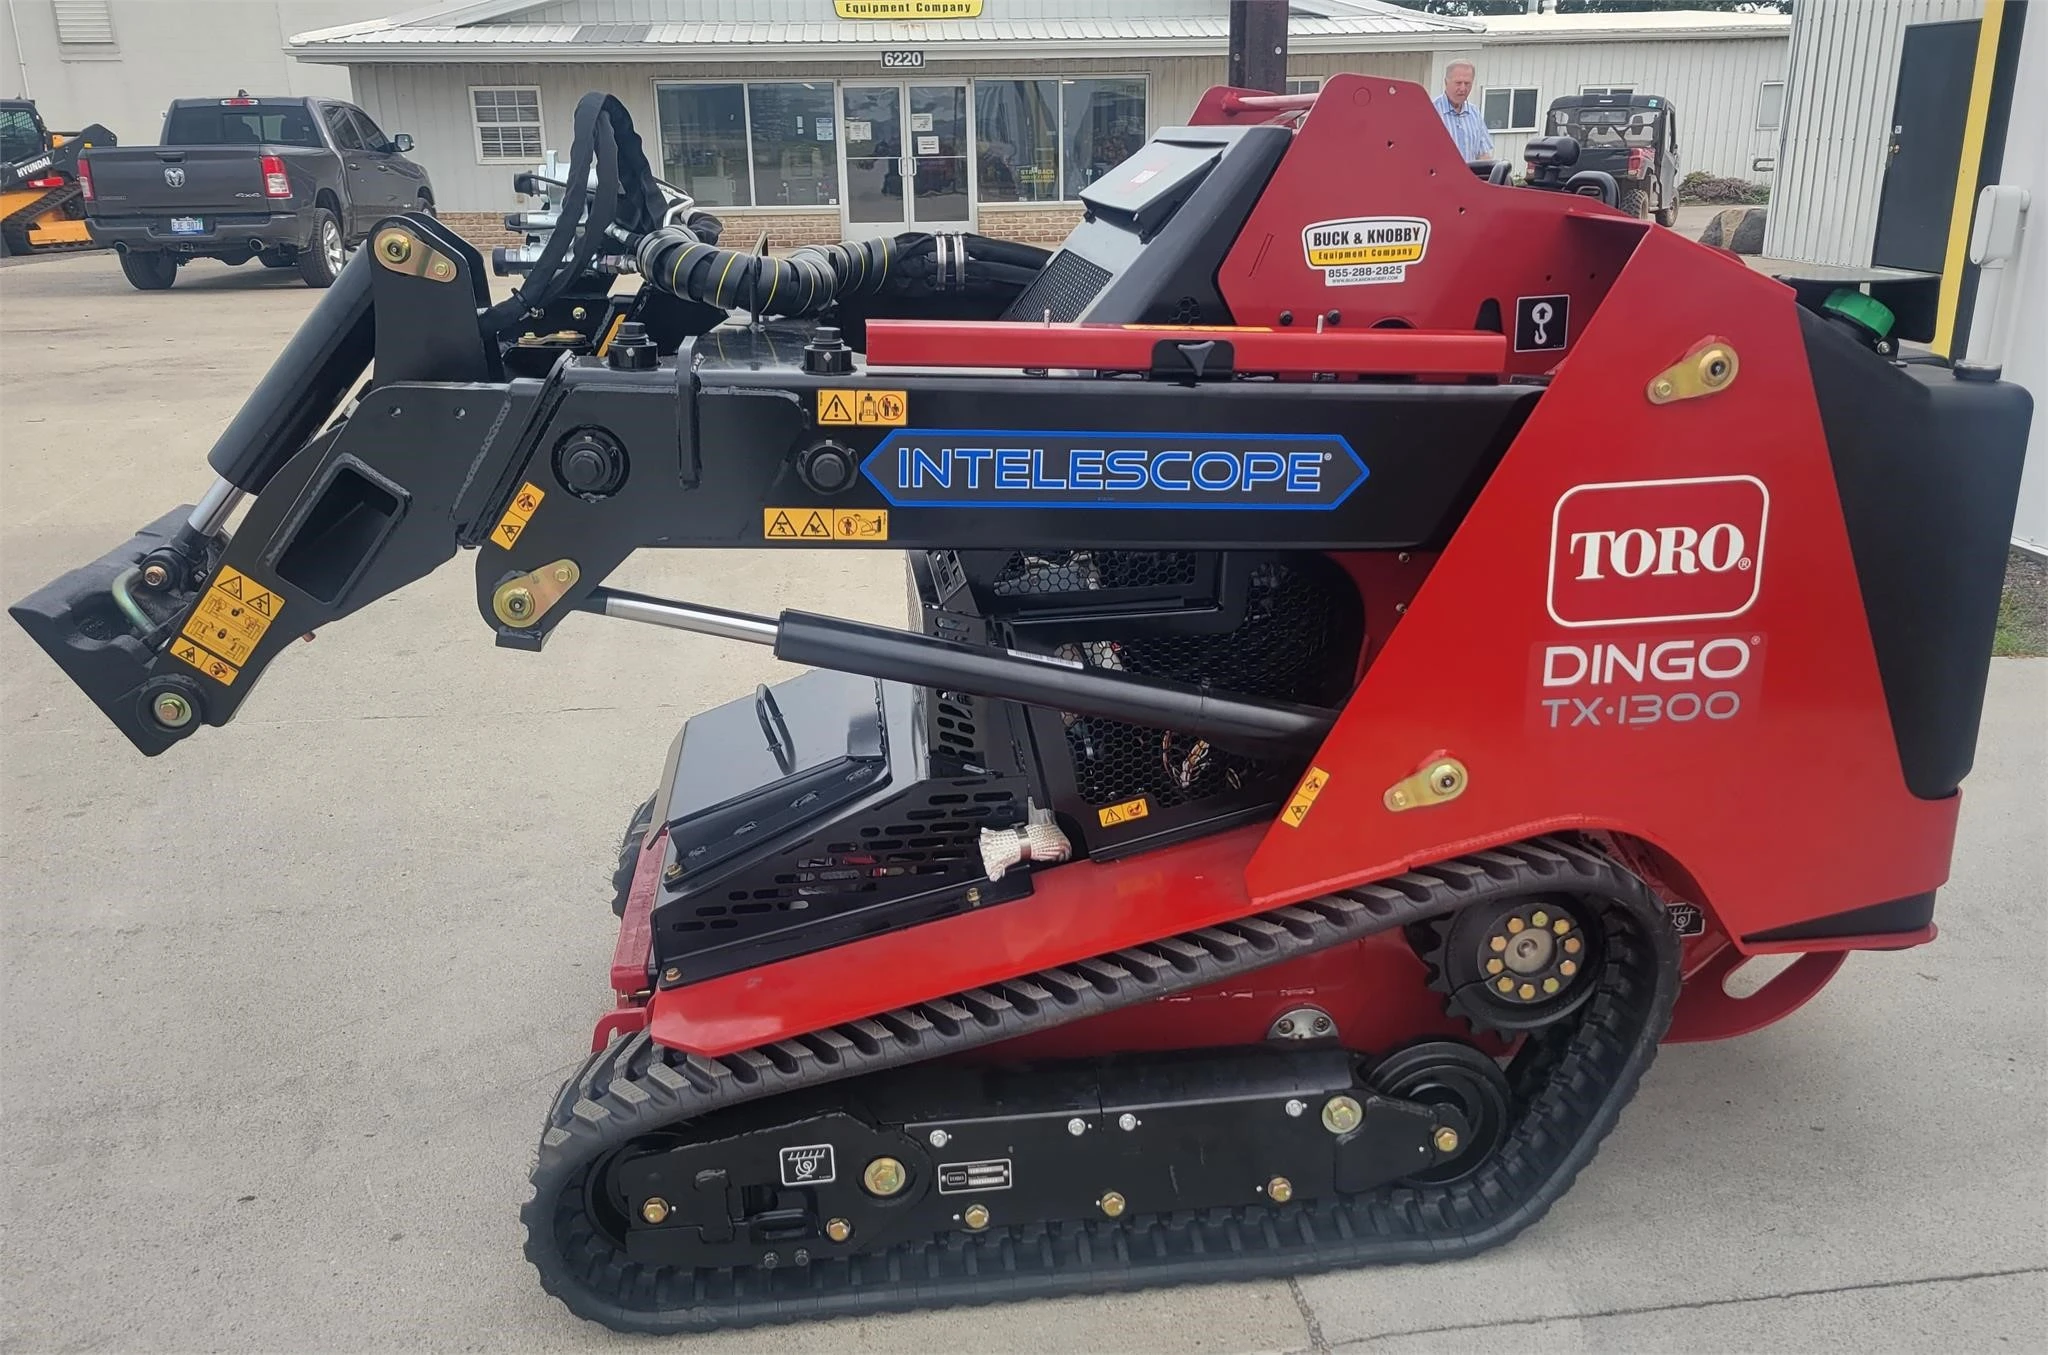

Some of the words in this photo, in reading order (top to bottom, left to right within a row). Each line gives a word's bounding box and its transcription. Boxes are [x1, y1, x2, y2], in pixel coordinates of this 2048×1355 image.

[845, 2, 910, 13] Equipment
[916, 2, 971, 13] Company
[884, 52, 922, 66] 6220
[16, 155, 52, 178] HYUNDAI
[1313, 231, 1349, 247] BUCK
[1354, 232, 1363, 245] &
[1367, 227, 1420, 244] KNOBBY
[1318, 249, 1367, 260] Equipment
[1371, 247, 1413, 257] Company
[1328, 266, 1402, 278] 855-288-2825
[898, 447, 1322, 492] INTELESCOPE
[1570, 523, 1745, 580] TORO
[1543, 638, 1750, 687] DINGO
